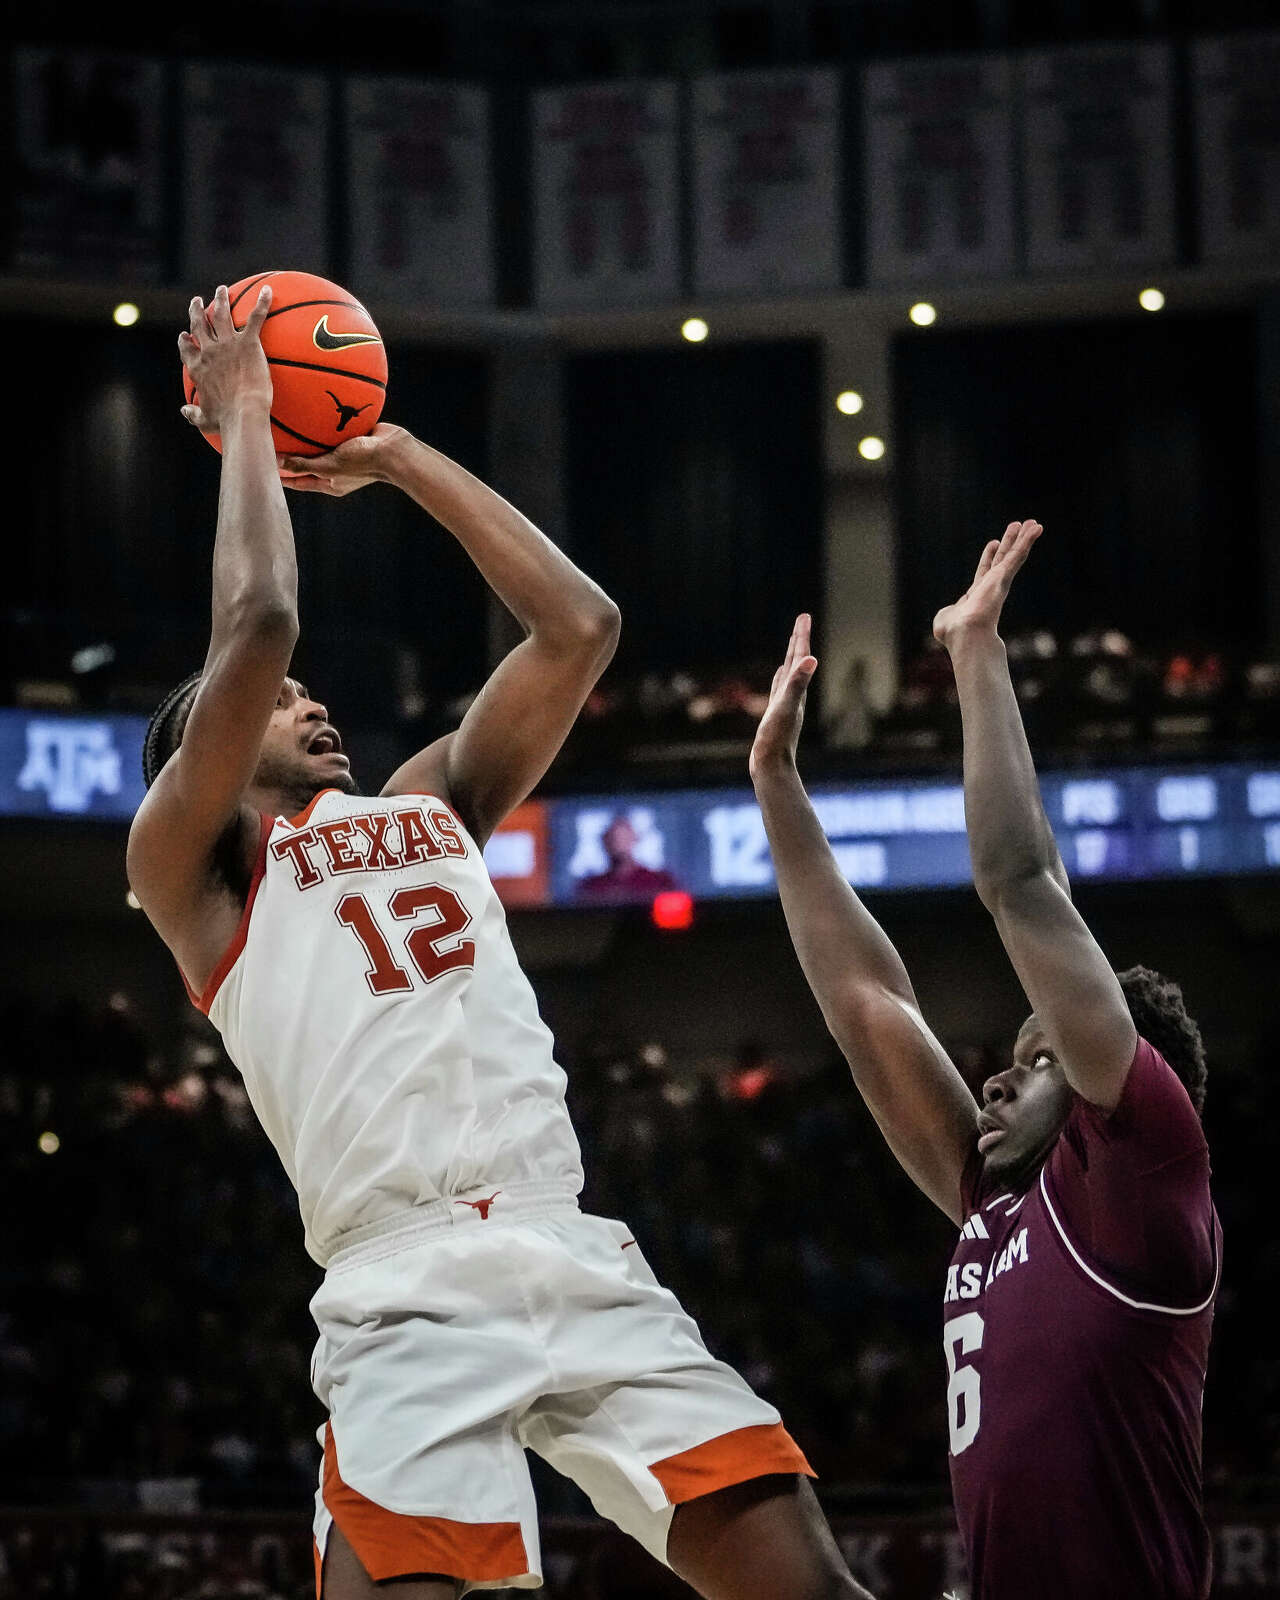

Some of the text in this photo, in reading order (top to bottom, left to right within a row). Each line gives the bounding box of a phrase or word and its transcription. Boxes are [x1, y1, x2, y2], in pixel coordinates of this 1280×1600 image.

[270, 807, 468, 892] TEXAS
[704, 805, 774, 886] 12
[334, 881, 477, 996] 12
